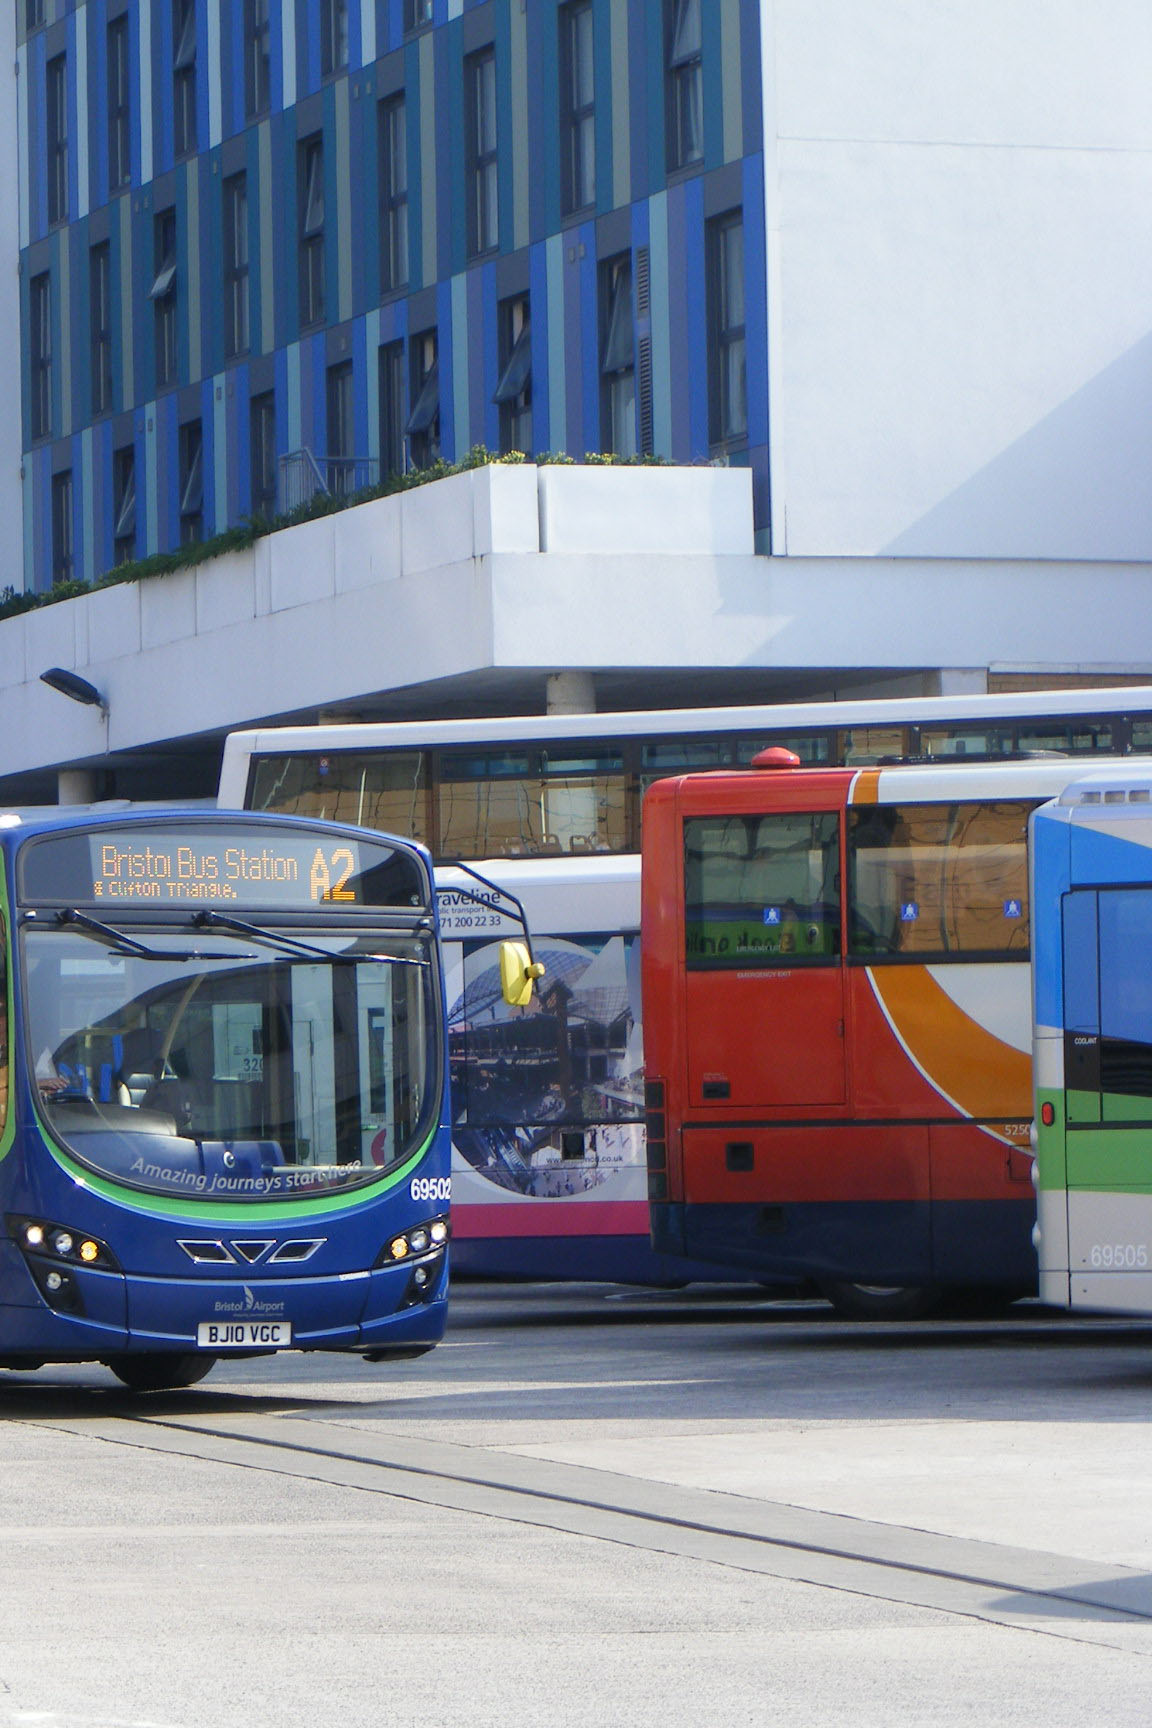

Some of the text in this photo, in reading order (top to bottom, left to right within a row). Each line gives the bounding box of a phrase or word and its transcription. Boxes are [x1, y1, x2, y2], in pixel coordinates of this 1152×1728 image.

[102, 845, 298, 881] Bristol Bus Station
[309, 848, 356, 900] A2
[109, 881, 161, 896] Clifton
[435, 888, 501, 906] raveline
[451, 906, 485, 915] transport
[455, 916, 473, 928] 200
[475, 915, 487, 927] 22
[489, 915, 501, 927] 33
[131, 1157, 362, 1194] Amazing journeys start here
[410, 1177, 452, 1201] 69502
[1090, 1244, 1147, 1267] 69505
[214, 1301, 285, 1313] Bristol Airport
[208, 1325, 281, 1343] BJ10 VGC
